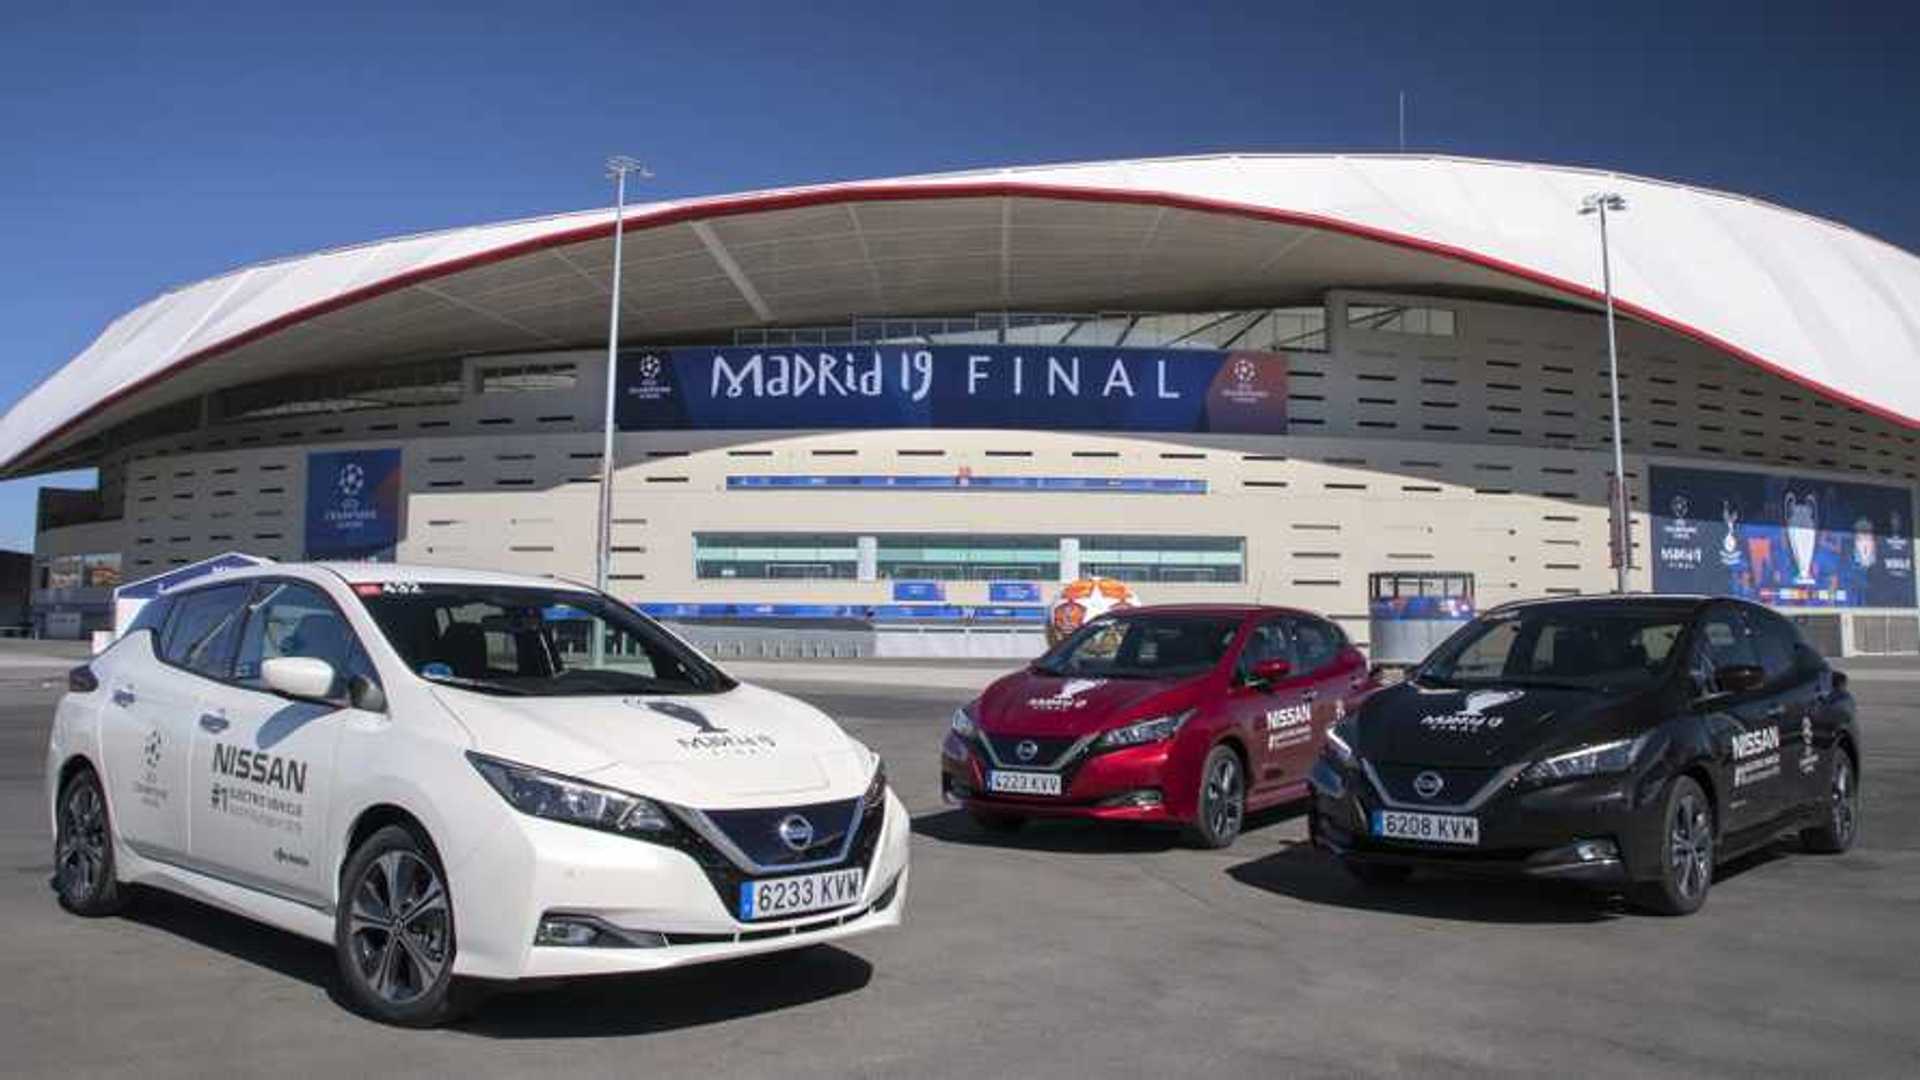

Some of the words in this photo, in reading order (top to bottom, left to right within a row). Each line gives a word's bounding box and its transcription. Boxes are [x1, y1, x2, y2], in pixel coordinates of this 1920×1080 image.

[902, 351, 933, 401] 19
[968, 355, 1180, 399] FINAL
[1265, 702, 1312, 732] NISSAN
[1732, 726, 1780, 761] NISSAN
[213, 743, 307, 794] NISSAN
[1386, 815, 1432, 836] 6208
[1438, 818, 1474, 840] KVW
[759, 879, 814, 911] 6233
[820, 873, 860, 902] KVW
